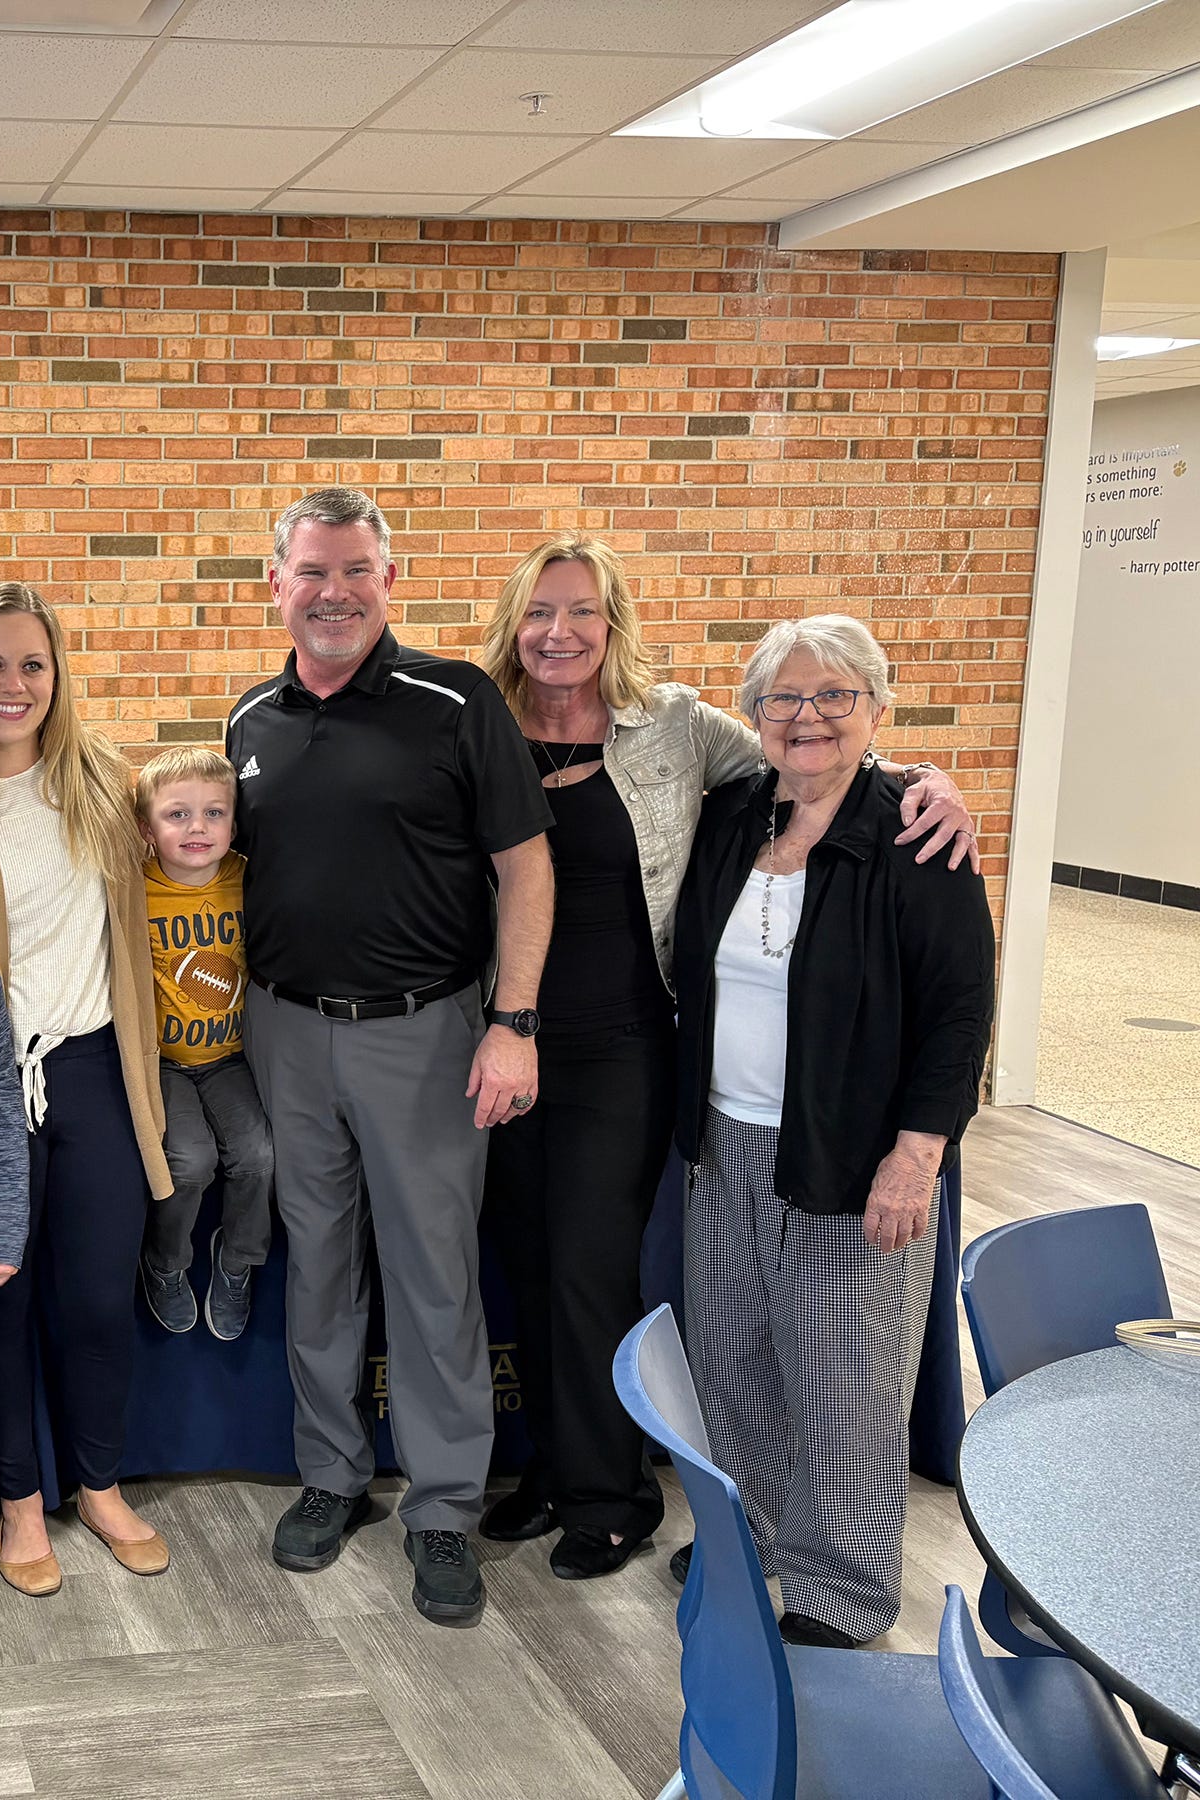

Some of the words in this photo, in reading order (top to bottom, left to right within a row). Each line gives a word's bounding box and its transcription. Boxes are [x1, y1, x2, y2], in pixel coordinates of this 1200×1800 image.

[1088, 454, 1105, 466] ard
[1096, 466, 1156, 484] something
[1099, 489, 1125, 502] even
[1129, 485, 1163, 499] more:
[1096, 525, 1106, 543] in
[1109, 518, 1161, 548] yourself
[1130, 560, 1160, 576] harry
[1163, 560, 1200, 576] potter
